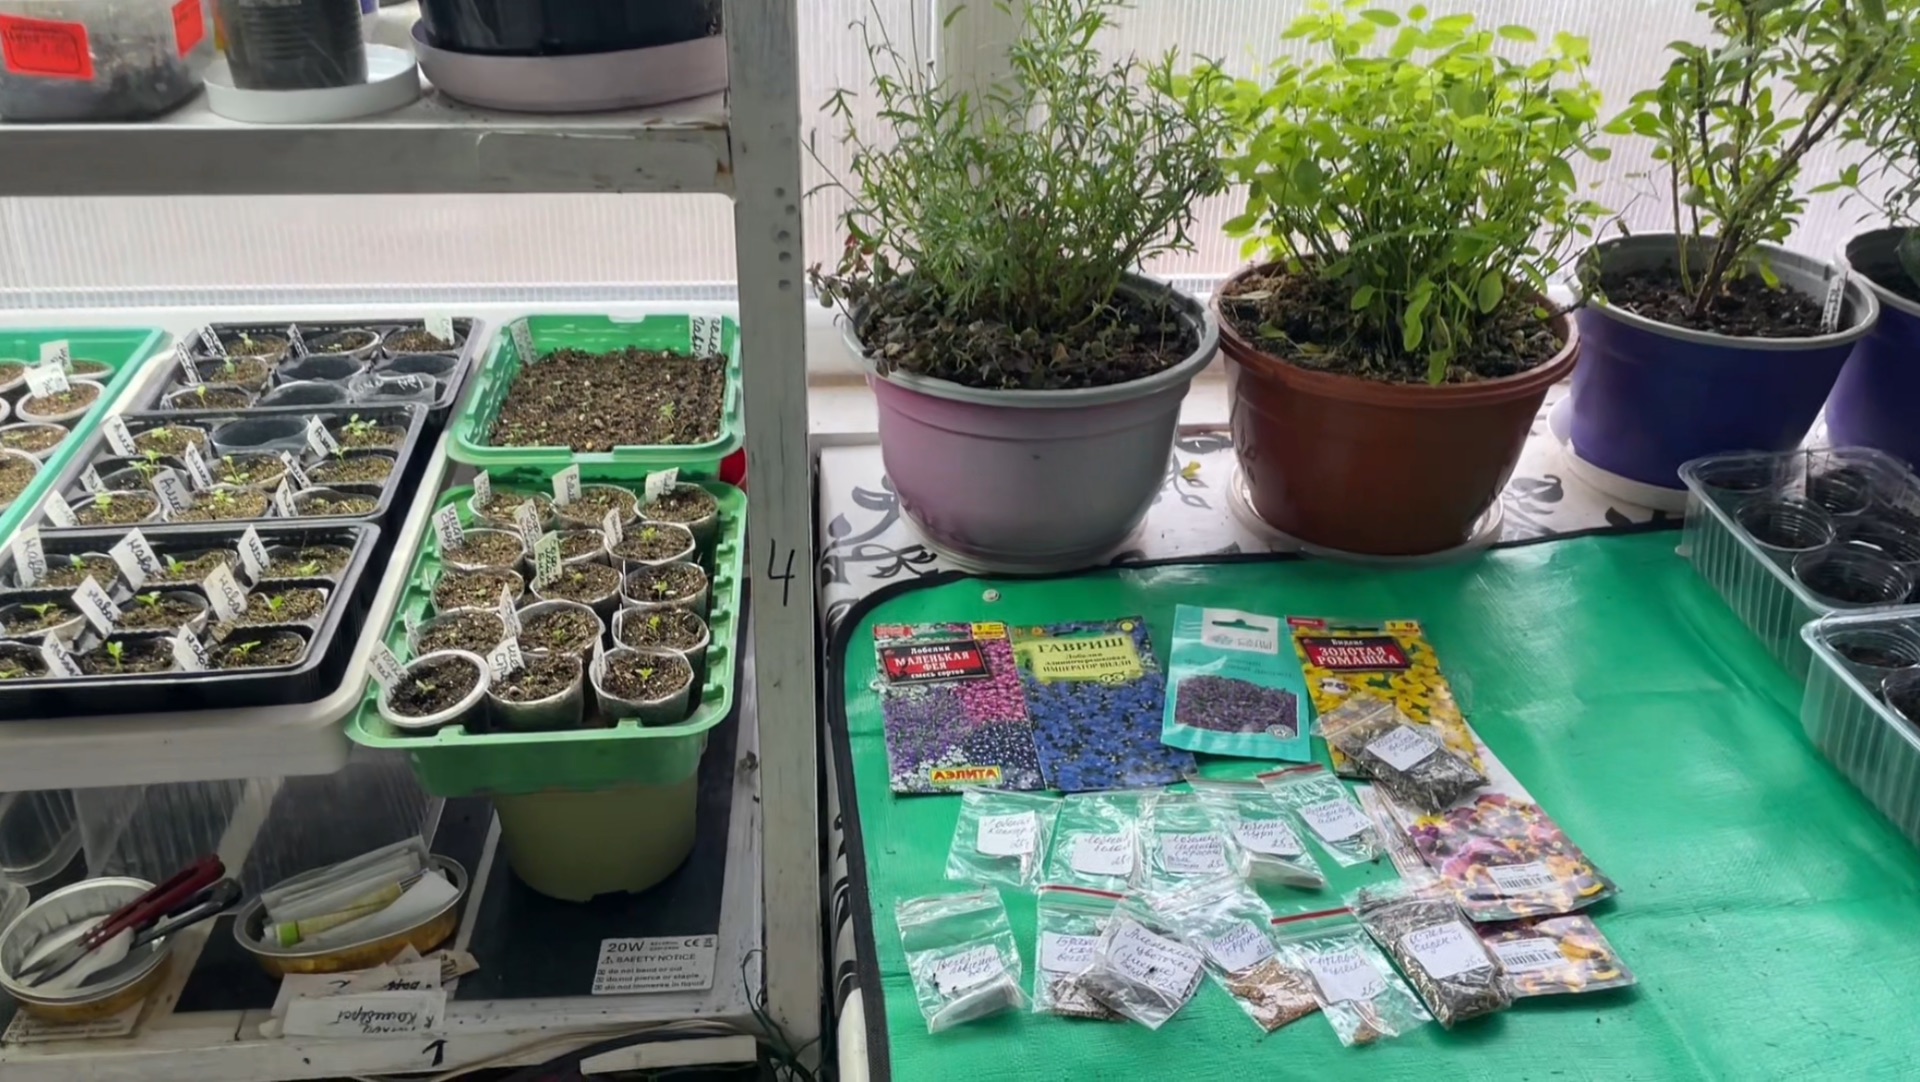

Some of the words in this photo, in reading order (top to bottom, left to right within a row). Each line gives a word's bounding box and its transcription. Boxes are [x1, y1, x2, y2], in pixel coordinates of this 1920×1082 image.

[767, 537, 796, 608] 4
[910, 645, 951, 655] Лобелия
[1037, 636, 1125, 653] ГАВРИШ
[1318, 646, 1387, 657] ЗОЛОТАЯ
[894, 650, 970, 668] МАЛЕНЬКАЯ
[1316, 656, 1400, 666] РОМАШКА
[922, 661, 948, 671] ФЕЯ
[1043, 662, 1098, 673] ИМПЕРАТОР
[933, 768, 999, 781] АЭЛИТА
[607, 941, 646, 954] 20W
[616, 955, 657, 964] SAFETY
[657, 953, 697, 962] NOTICE
[608, 966, 619, 975] do
[620, 966, 635, 974] not
[658, 965, 668, 973] or
[606, 975, 617, 983] do
[618, 974, 633, 983] not
[662, 973, 672, 981] or
[604, 983, 616, 991] do
[617, 982, 632, 990] not
